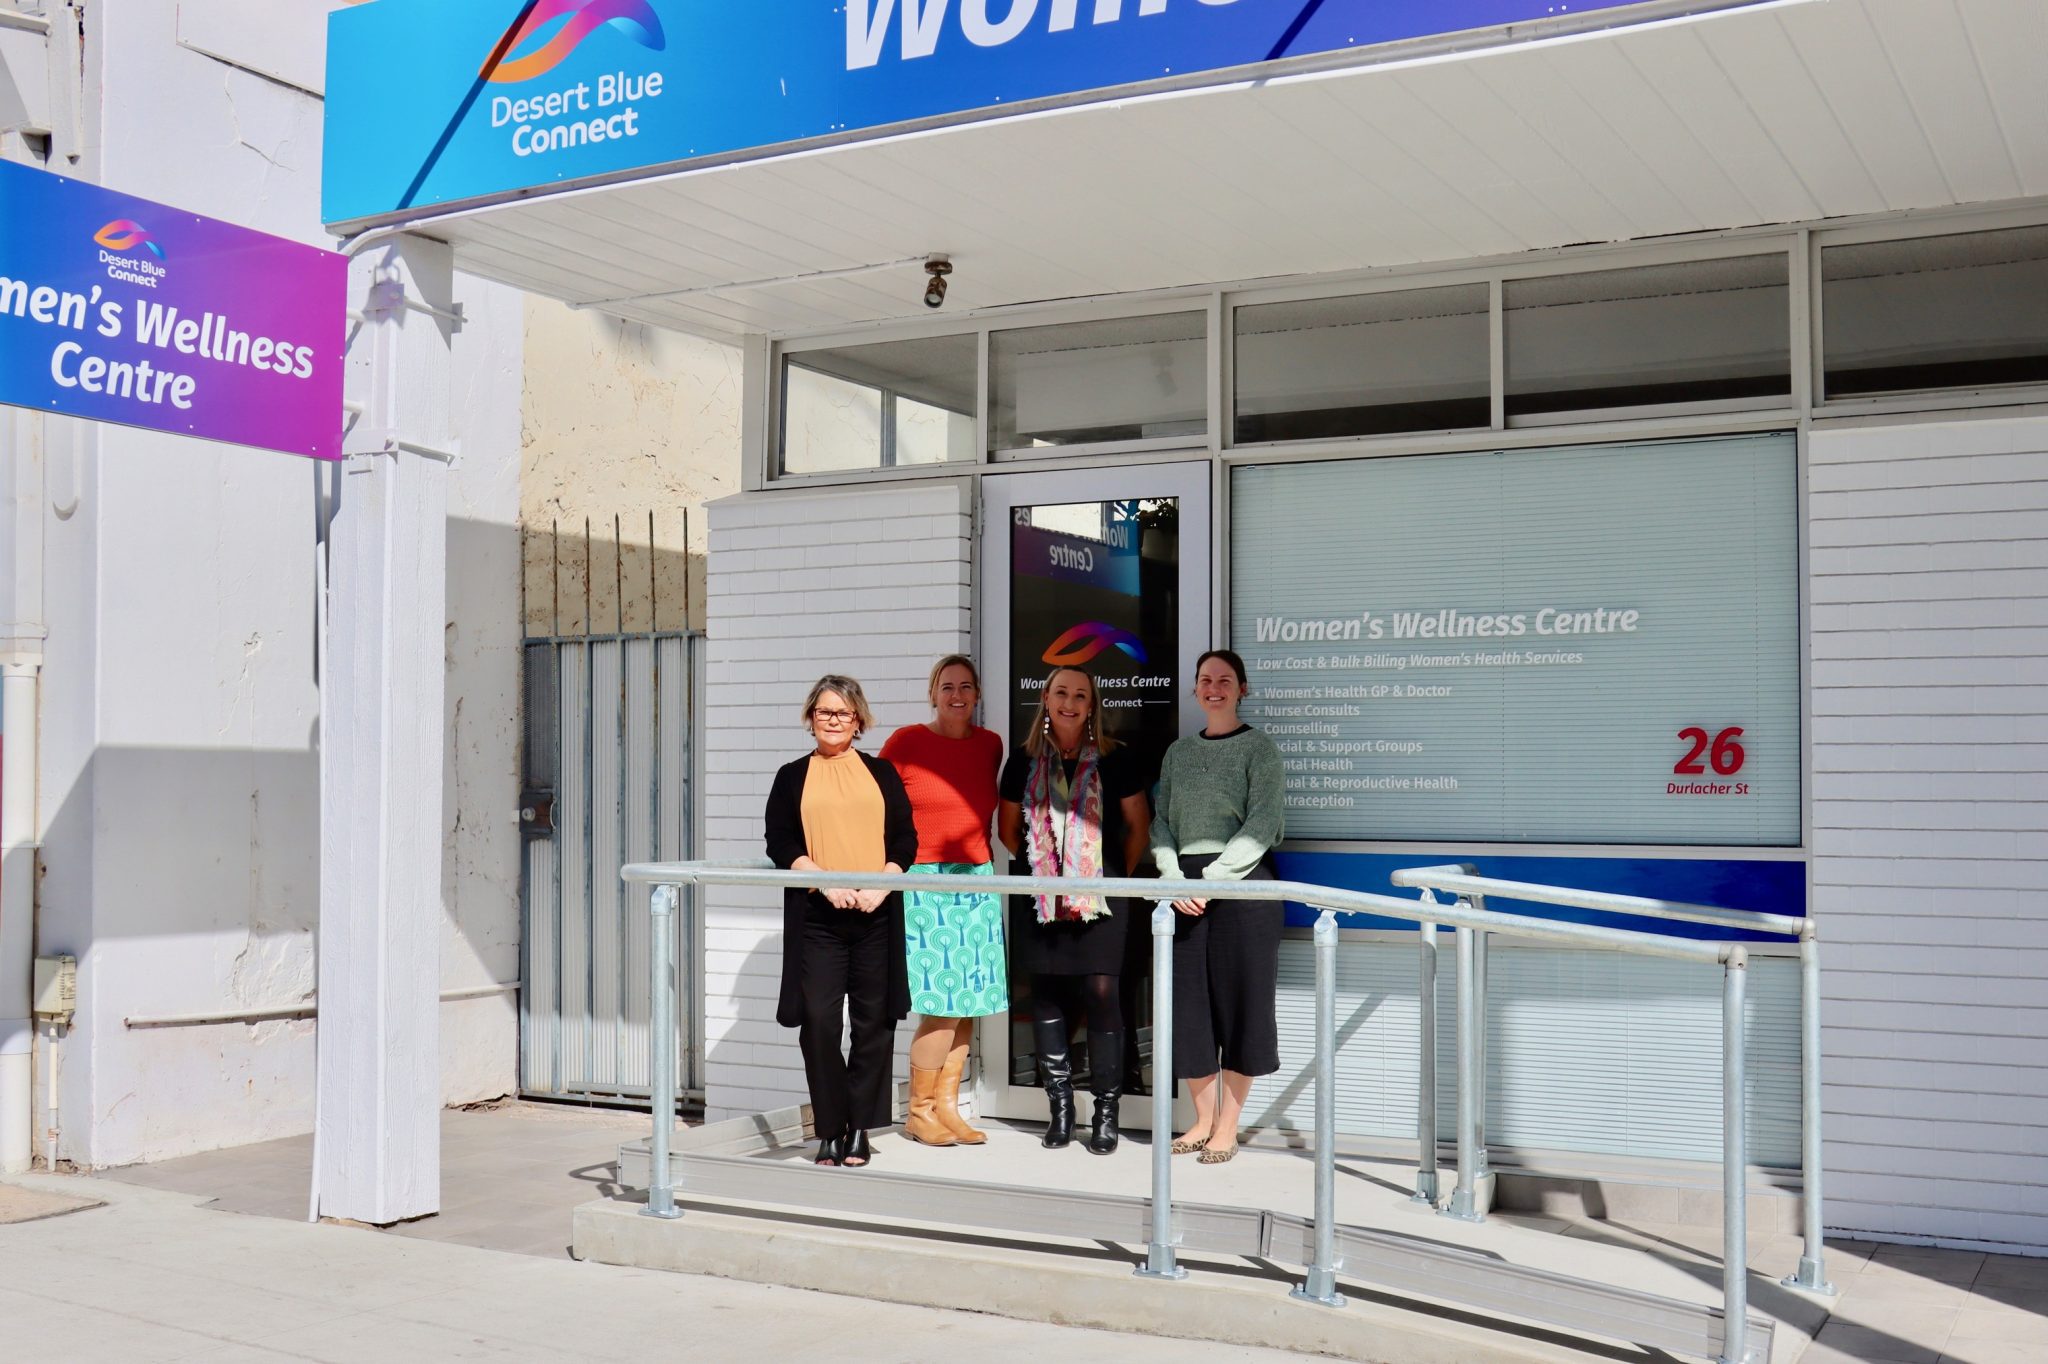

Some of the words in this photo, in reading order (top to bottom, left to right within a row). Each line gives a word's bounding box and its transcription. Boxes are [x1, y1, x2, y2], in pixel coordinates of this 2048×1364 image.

[491, 82, 590, 127] Desert
[598, 71, 663, 107] Blue
[512, 107, 639, 157] Connect
[99, 249, 139, 271] Desert
[141, 260, 166, 277] Blue
[107, 265, 157, 288] Connect
[136, 299, 314, 378] Wellness
[51, 341, 196, 409] Centre
[1256, 611, 1384, 642] Women's
[1393, 609, 1527, 639] Wellness
[1535, 608, 1640, 635] Centre
[1257, 658, 1282, 670] Low
[1285, 656, 1314, 669] Cost
[1316, 656, 1327, 668] &
[1331, 655, 1360, 668] Bulk
[1364, 653, 1407, 670] Billing
[1410, 652, 1471, 666] Women's
[1475, 651, 1521, 665] Health
[1524, 650, 1584, 664] Services
[1131, 675, 1171, 688] Centre
[1264, 686, 1322, 699] Women's
[1325, 685, 1367, 698] Health
[1371, 685, 1389, 697] GP
[1392, 685, 1404, 697] &
[1407, 685, 1453, 697] Doctor
[1102, 698, 1143, 708] Connect
[1264, 705, 1302, 717] Nurse
[1304, 704, 1360, 717] Consults
[1264, 721, 1339, 737] Counselling
[1277, 739, 1302, 753] cial
[1306, 740, 1317, 752] &
[1320, 740, 1372, 755] Support
[1375, 740, 1423, 755] Groups
[1673, 726, 1745, 776] 26
[1283, 757, 1308, 771] ntal
[1311, 758, 1353, 771] Health
[1286, 776, 1306, 789] ual
[1310, 776, 1320, 788] &
[1323, 775, 1410, 790] Reproductive
[1414, 776, 1458, 790] Health
[1666, 782, 1732, 795] Durlacher
[1735, 783, 1749, 795] St
[1283, 794, 1354, 809] traception
